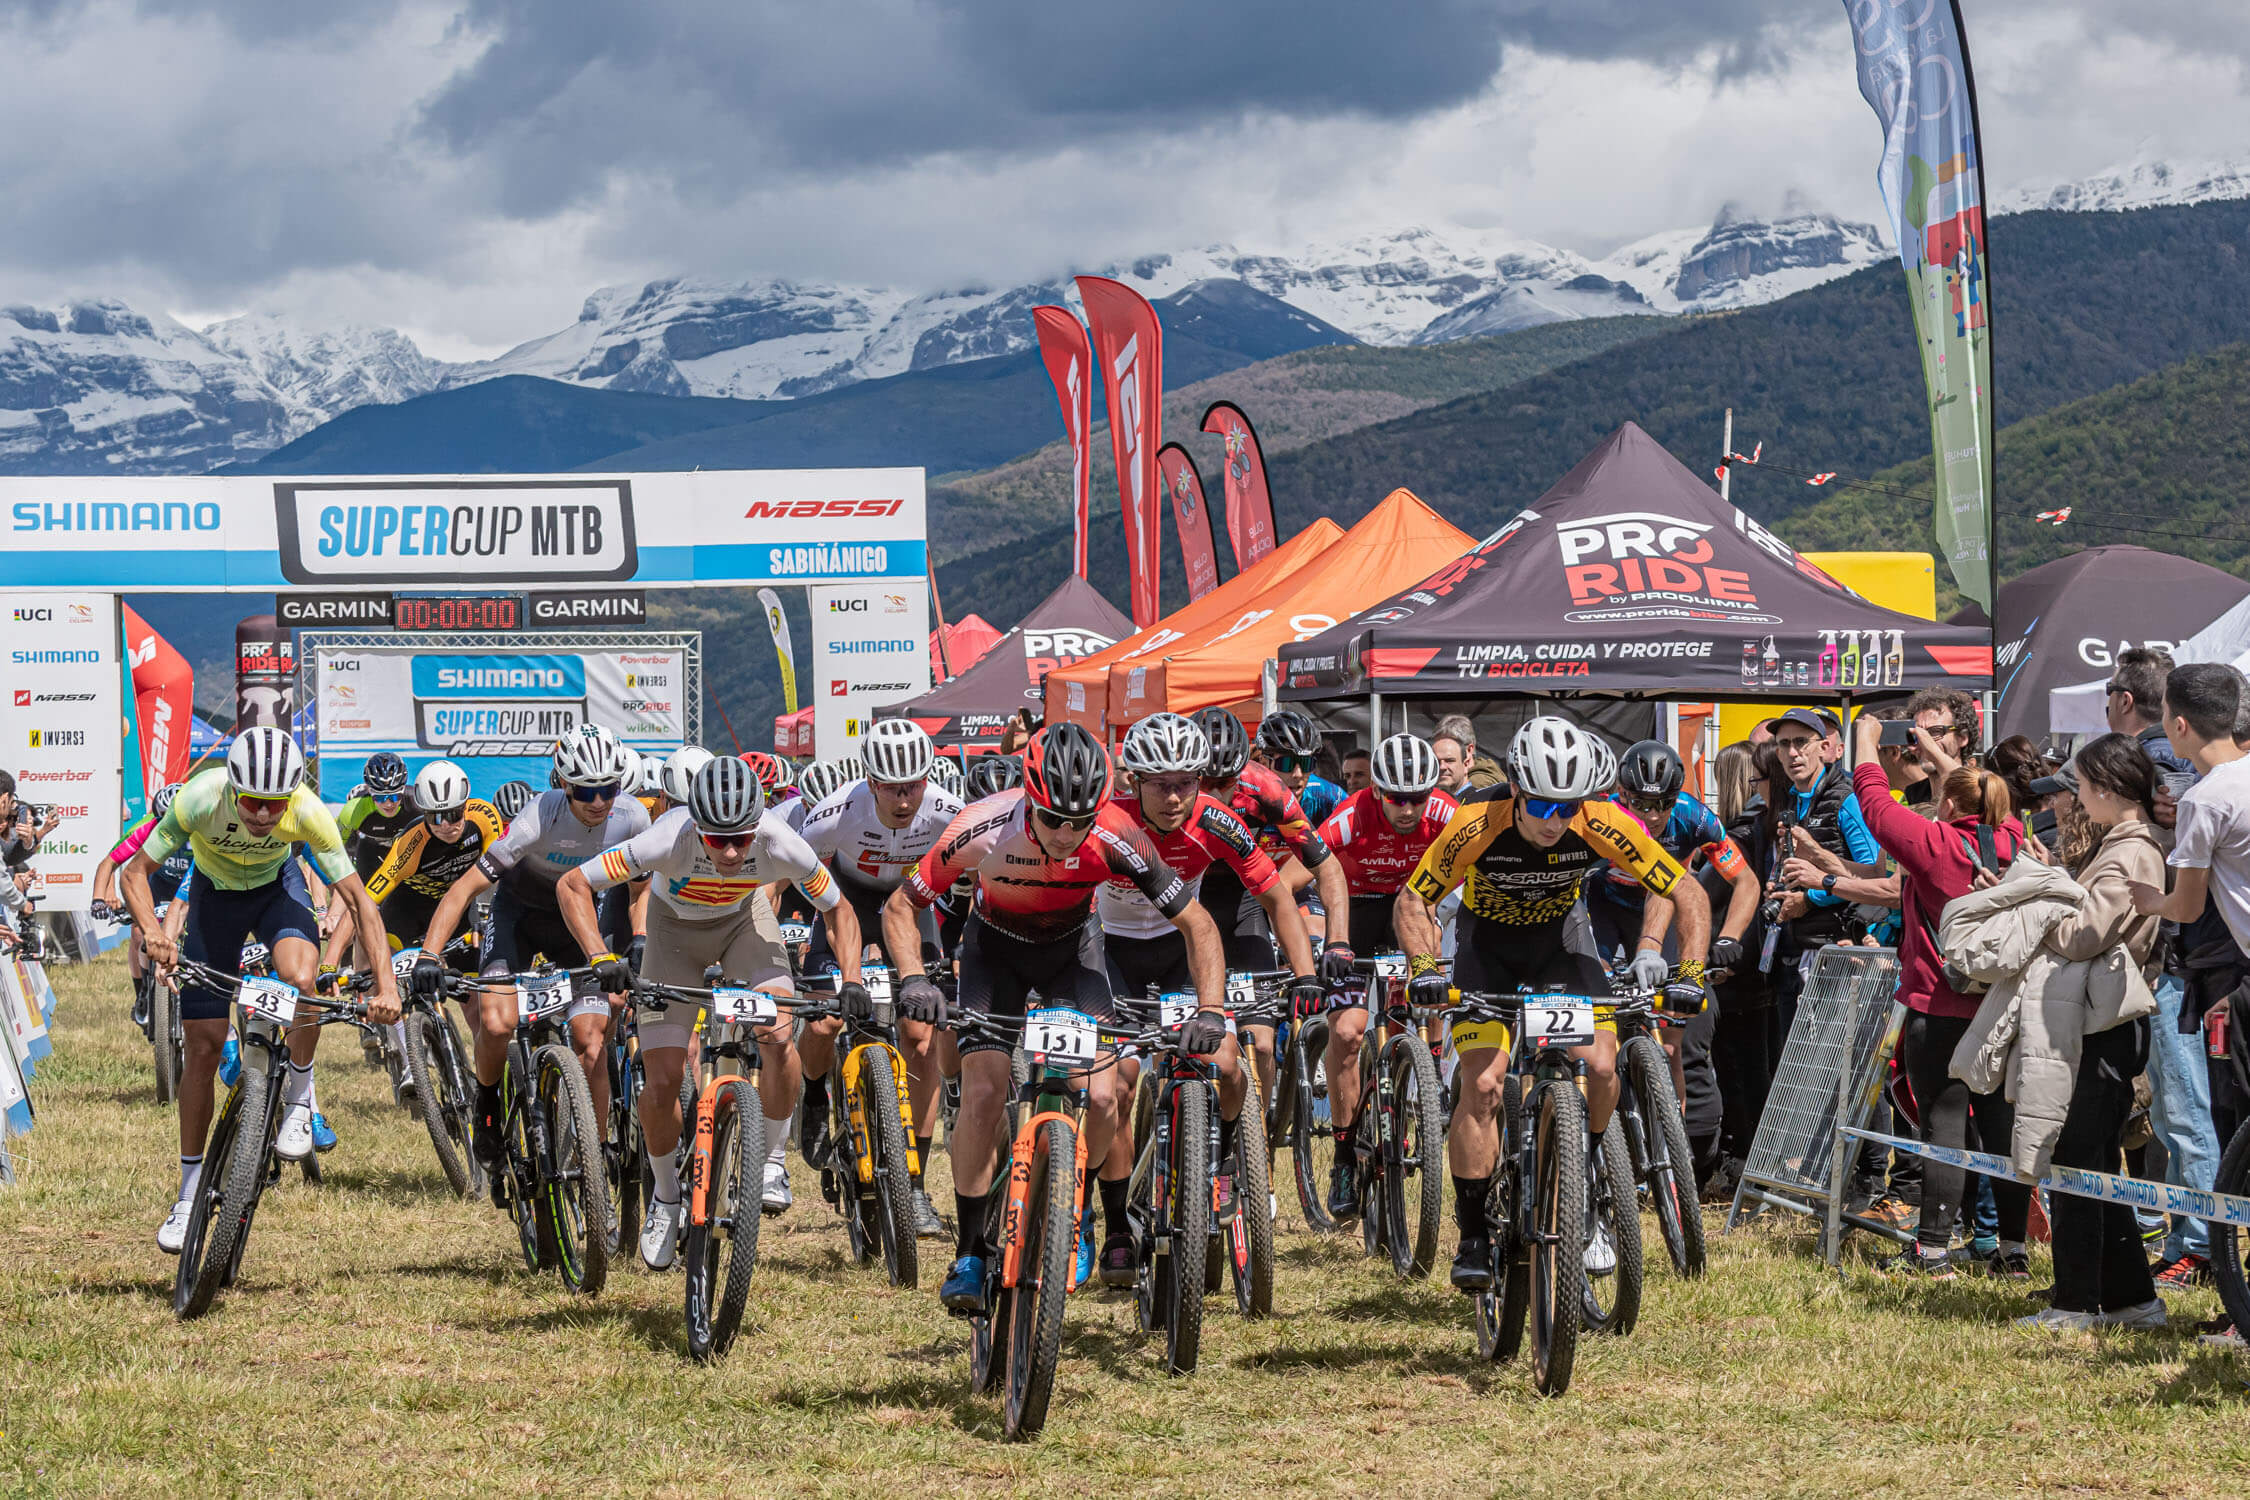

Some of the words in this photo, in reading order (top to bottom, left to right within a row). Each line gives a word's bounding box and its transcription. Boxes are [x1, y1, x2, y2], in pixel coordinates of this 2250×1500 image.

[13, 502, 221, 531] SHIMANO
[531, 504, 603, 557] MTB
[1557, 520, 1714, 566] PRO
[769, 542, 888, 576] SABIÑÁNIGO
[1565, 557, 1758, 606] RIDE
[837, 599, 868, 612] UCI
[1609, 595, 1628, 605] by
[1631, 591, 1760, 610] PROQUIMIA
[21, 608, 53, 621] UCI
[11, 650, 100, 664] SHIMANO
[242, 642, 273, 658] PRO
[828, 639, 915, 654] SHIMANO
[1456, 643, 1530, 664] LIMPIA,
[1534, 642, 1597, 661] CUIDA
[1603, 643, 1618, 658] Y
[1619, 642, 1714, 658] PROTEGE
[243, 656, 279, 670] RIDE
[335, 660, 360, 671] UCI
[1457, 663, 1484, 678] TU
[1488, 661, 1591, 678] BICICLETA
[438, 668, 564, 689] SHIMANO
[538, 710, 574, 736] MTB
[961, 726, 978, 738] TU
[18, 769, 95, 782] Powerbar
[804, 800, 853, 827] SCOTT
[1203, 806, 1237, 830] ALPEN
[1587, 817, 1645, 864] GIANT
[255, 991, 279, 1013] 43
[527, 988, 562, 1012] 323
[1546, 1010, 1575, 1033] 22
[2059, 1168, 2105, 1196] SHIMANO
[2111, 1177, 2159, 1207] SHIMANO
[2165, 1187, 2216, 1218] SHIMANO
